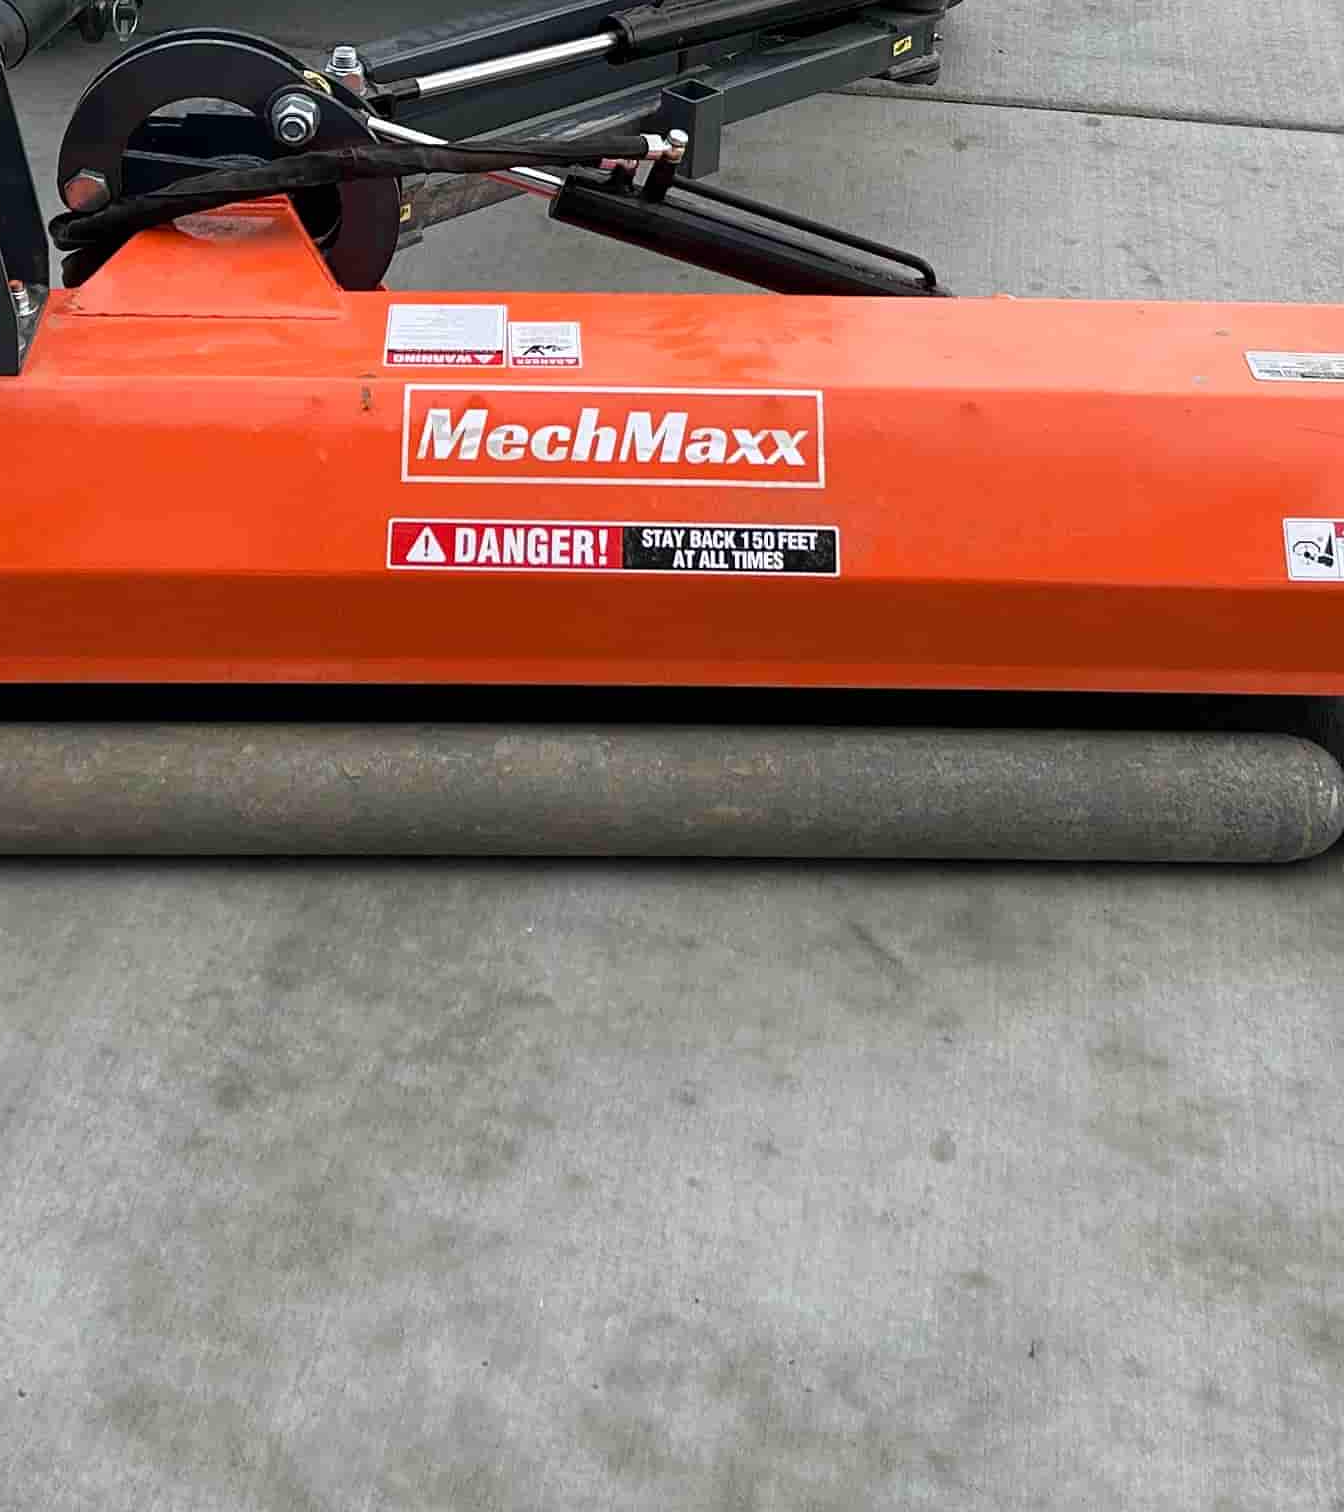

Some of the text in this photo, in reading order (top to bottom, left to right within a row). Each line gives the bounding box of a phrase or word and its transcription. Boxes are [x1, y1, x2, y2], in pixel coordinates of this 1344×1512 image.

[393, 353, 473, 364] WARNING
[416, 407, 809, 466] MechMaxx
[454, 527, 609, 566] DANGER!
[641, 529, 819, 551] STAY BACK 150 FEET
[672, 550, 785, 570] AT ALL TIMES
